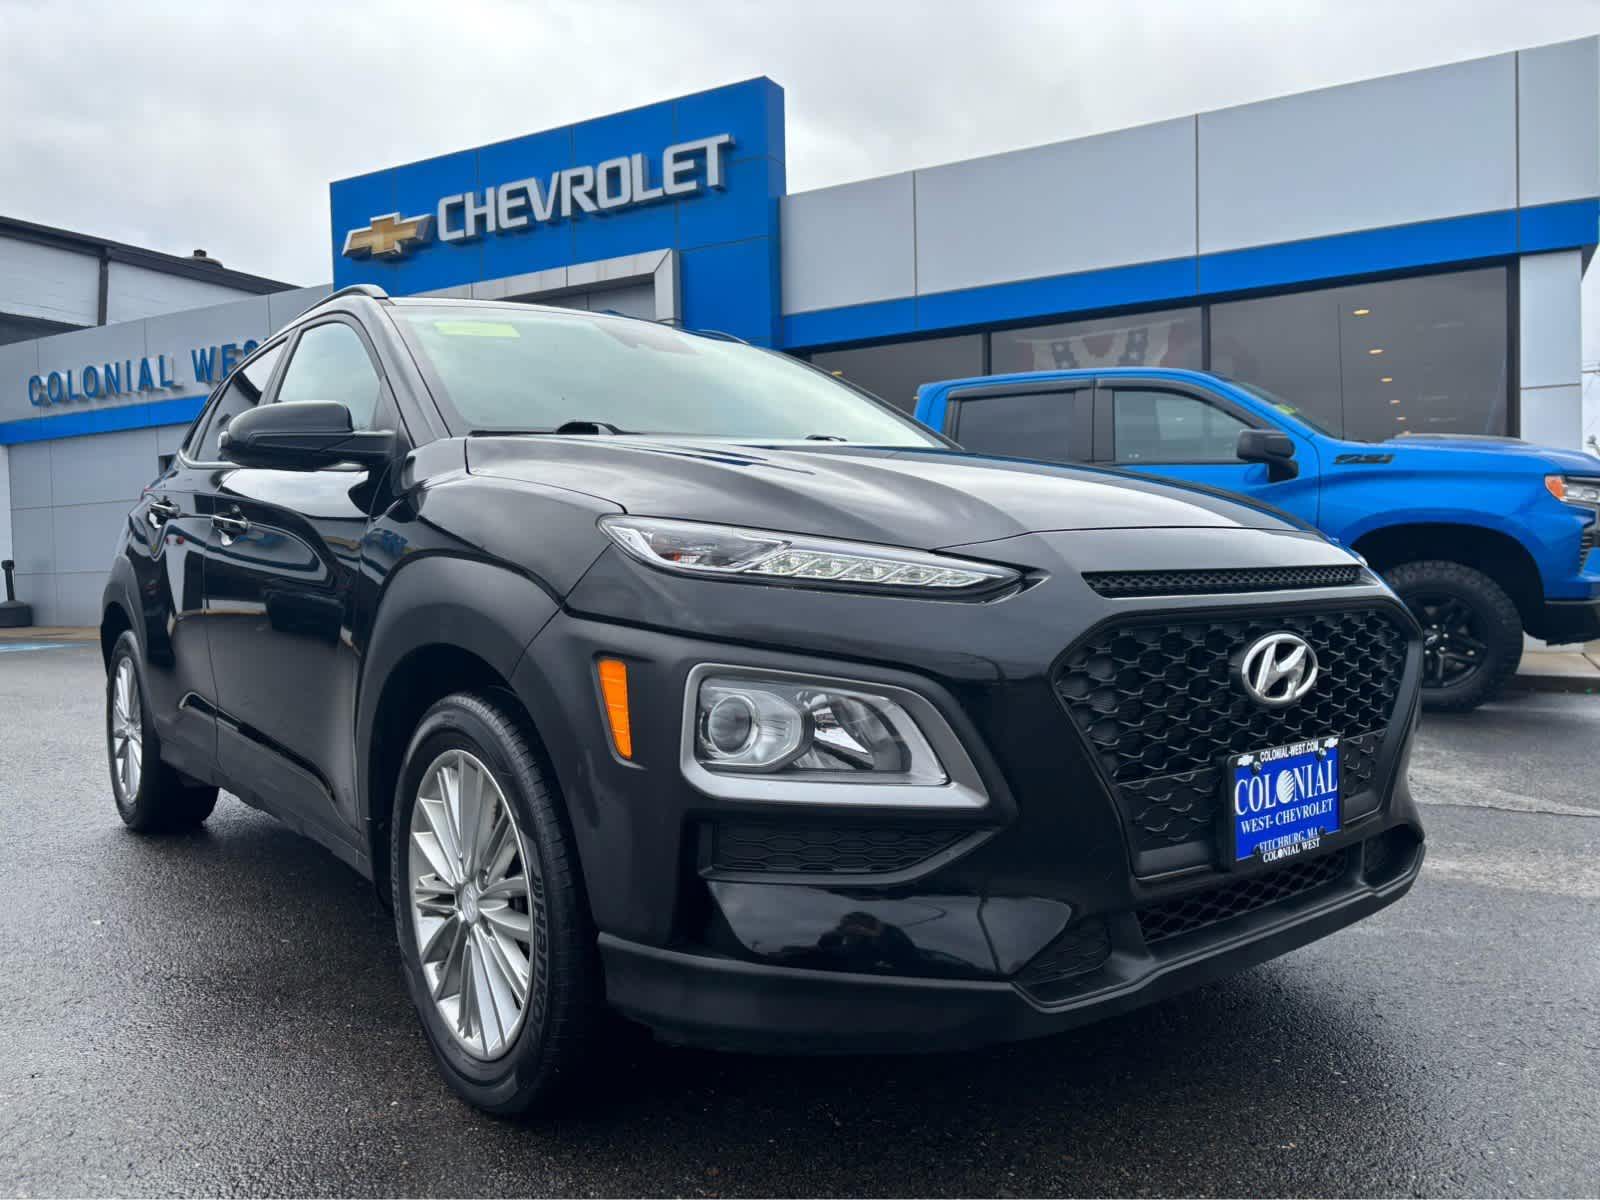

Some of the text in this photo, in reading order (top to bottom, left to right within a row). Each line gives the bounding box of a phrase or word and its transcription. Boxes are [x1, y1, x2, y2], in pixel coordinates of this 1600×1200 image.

[437, 133, 736, 243] CHEVROLET
[28, 337, 270, 406] COLONIAL WE
[1260, 739, 1319, 762] COLONIAL-WEST.COM
[1234, 760, 1338, 816] COLONIAL
[1275, 798, 1334, 826] CHEVROLET
[1263, 838, 1321, 863] COLONIAL WEST
